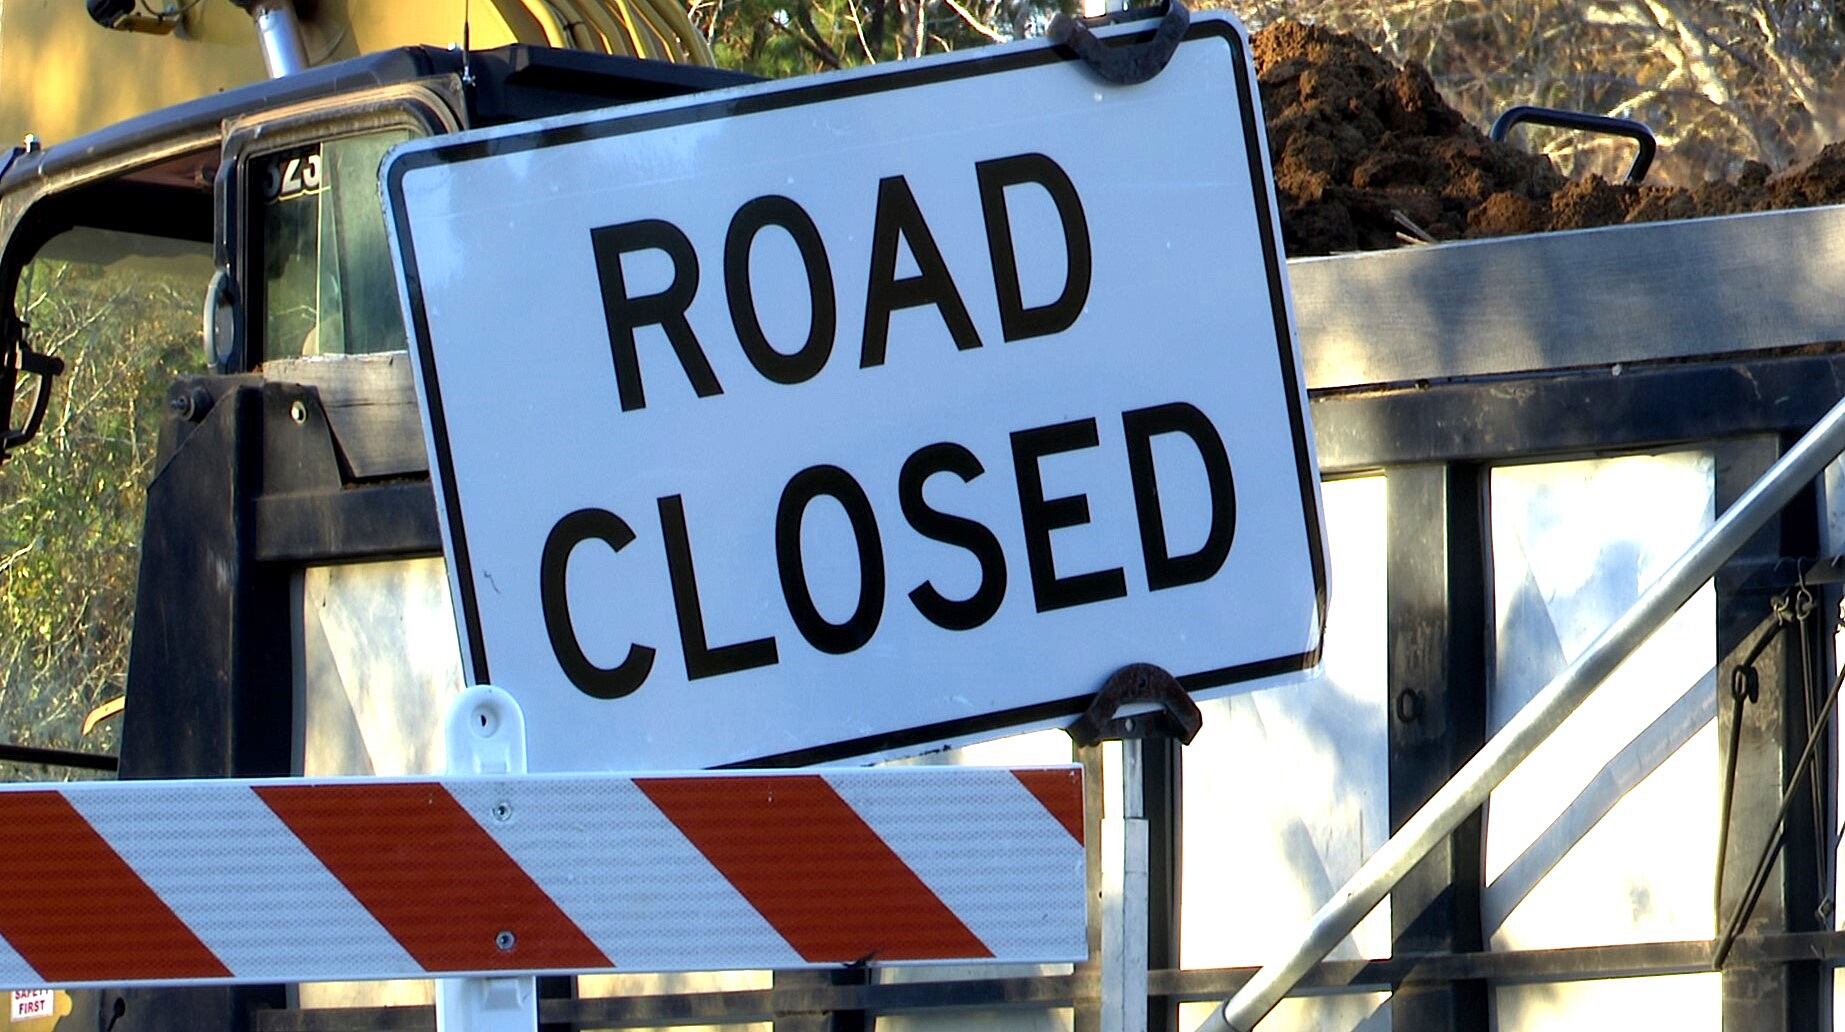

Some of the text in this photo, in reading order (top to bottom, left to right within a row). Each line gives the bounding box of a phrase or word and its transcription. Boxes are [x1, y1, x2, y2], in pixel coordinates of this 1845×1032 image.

[590, 153, 1092, 412] ROAD
[540, 402, 1237, 699] CLOSED
[19, 1000, 45, 1014] FIRST
